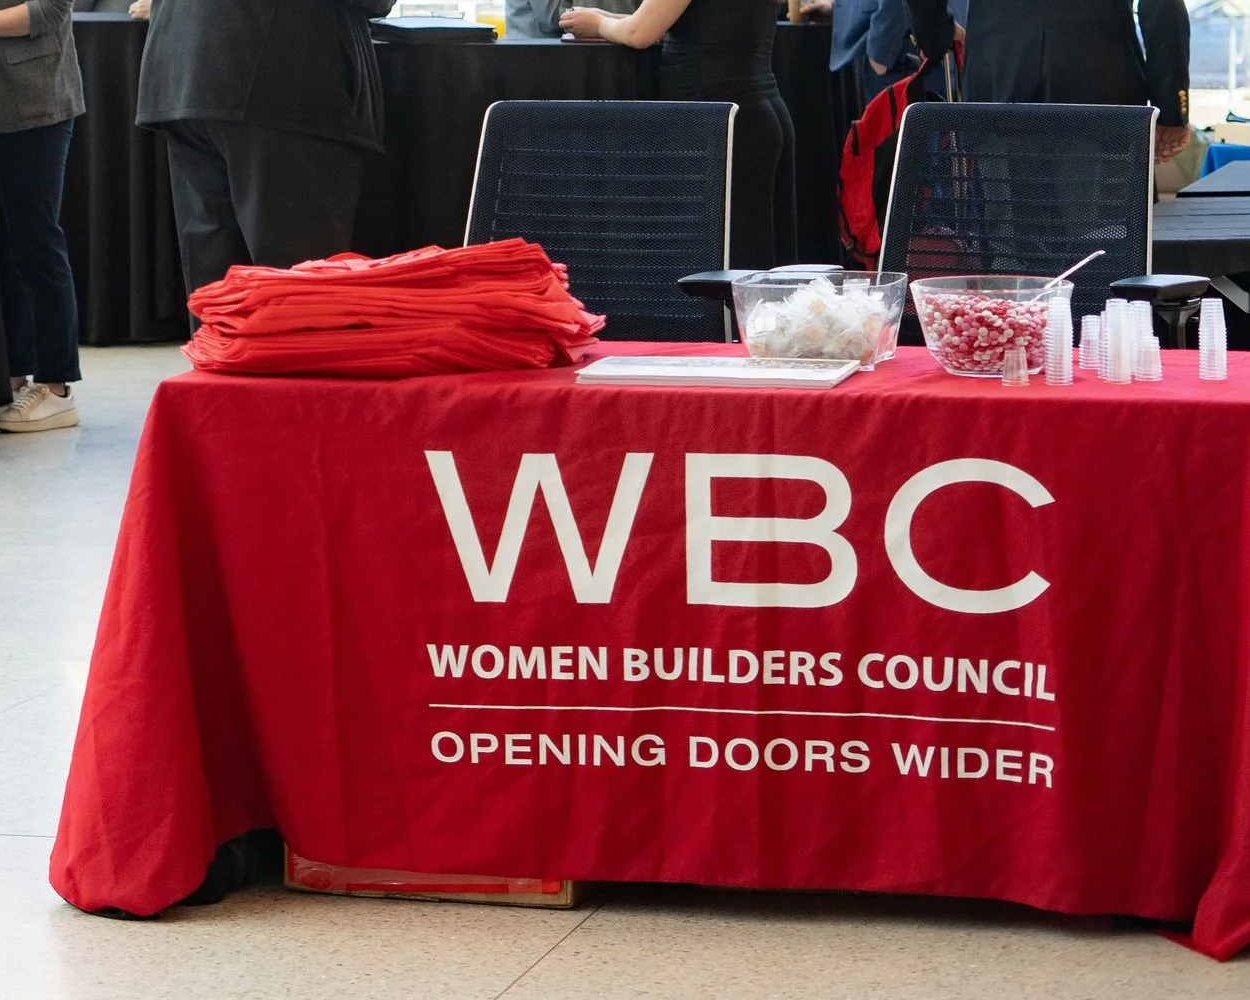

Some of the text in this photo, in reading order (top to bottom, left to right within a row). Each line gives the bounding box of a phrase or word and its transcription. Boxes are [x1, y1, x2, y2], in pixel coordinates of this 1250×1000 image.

[424, 451, 1055, 613] WBC
[427, 644, 1056, 701] WOMEN BUILDERS COUNCIL
[432, 732, 1054, 788] OPENING DOORS WIDER
